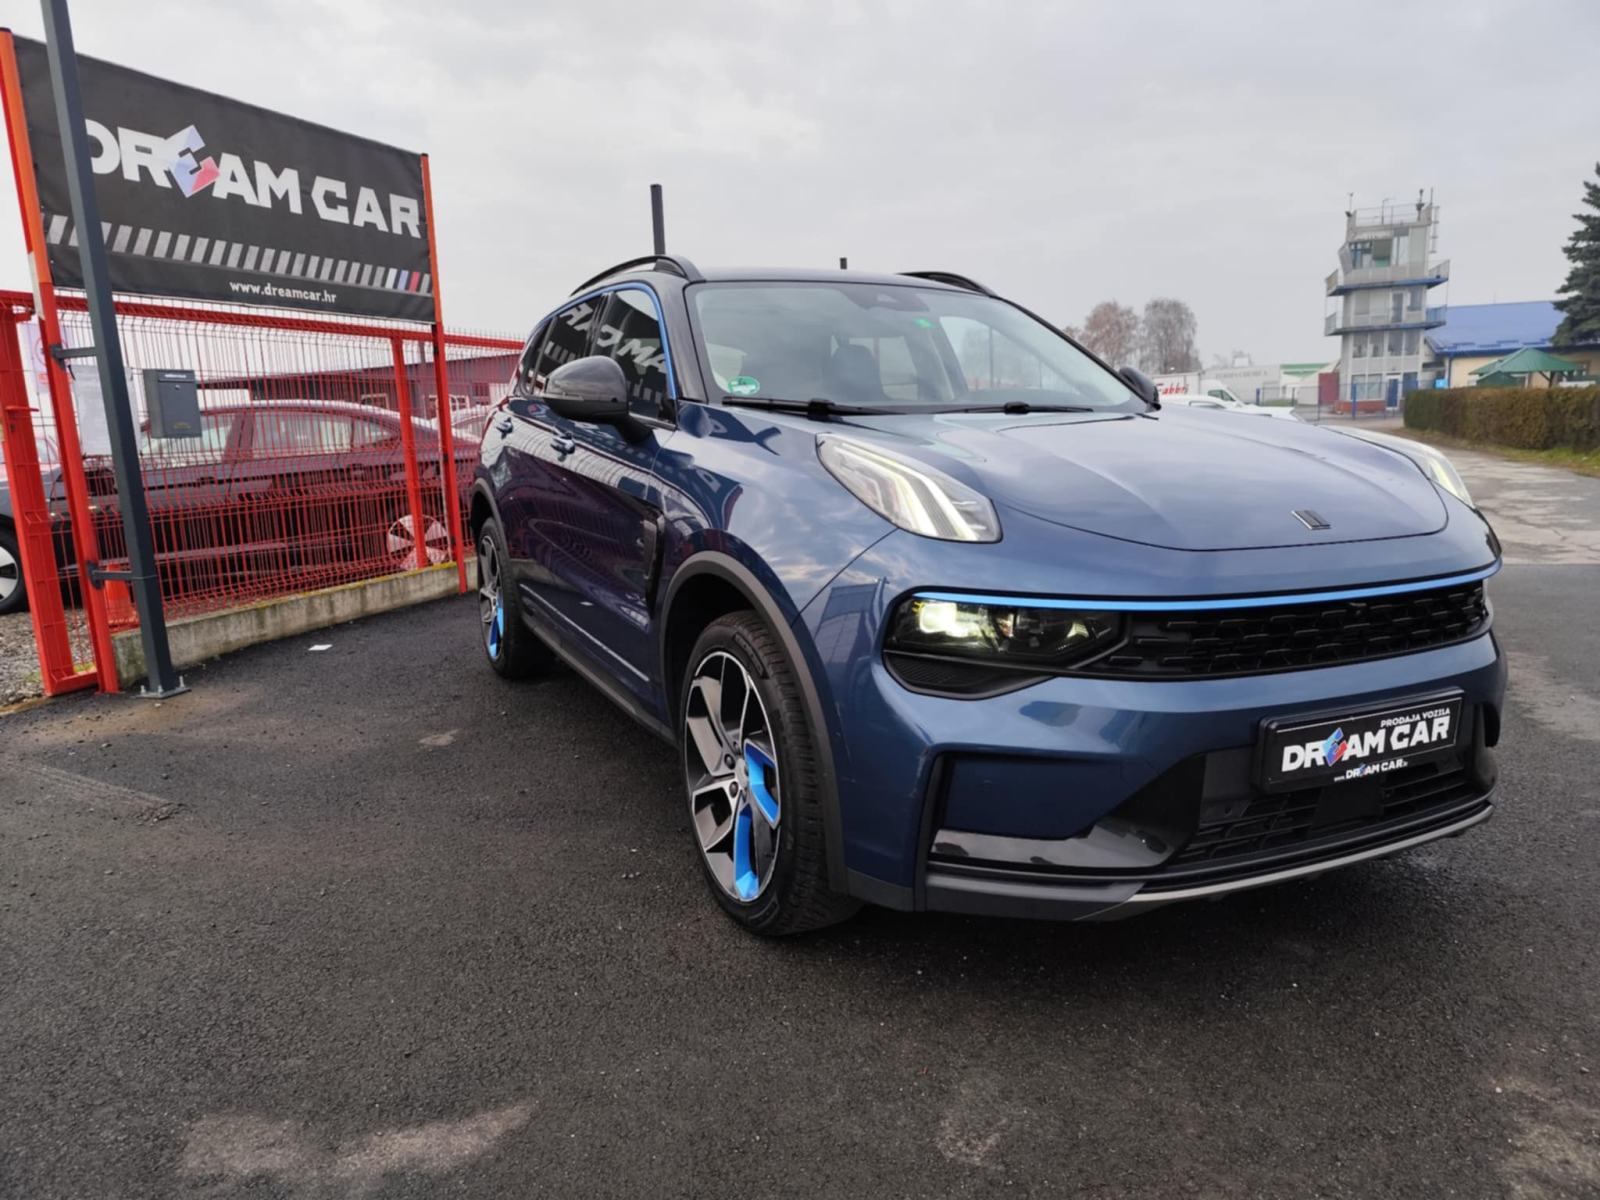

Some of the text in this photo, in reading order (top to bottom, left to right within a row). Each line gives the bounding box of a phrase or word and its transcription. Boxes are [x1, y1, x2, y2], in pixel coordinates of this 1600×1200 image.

[85, 119, 422, 238] DREAM CAR
[229, 279, 337, 304] www.dreamcar.hr
[1380, 713, 1421, 728] PRODAJA
[1282, 715, 1451, 771] DREAM CAR
